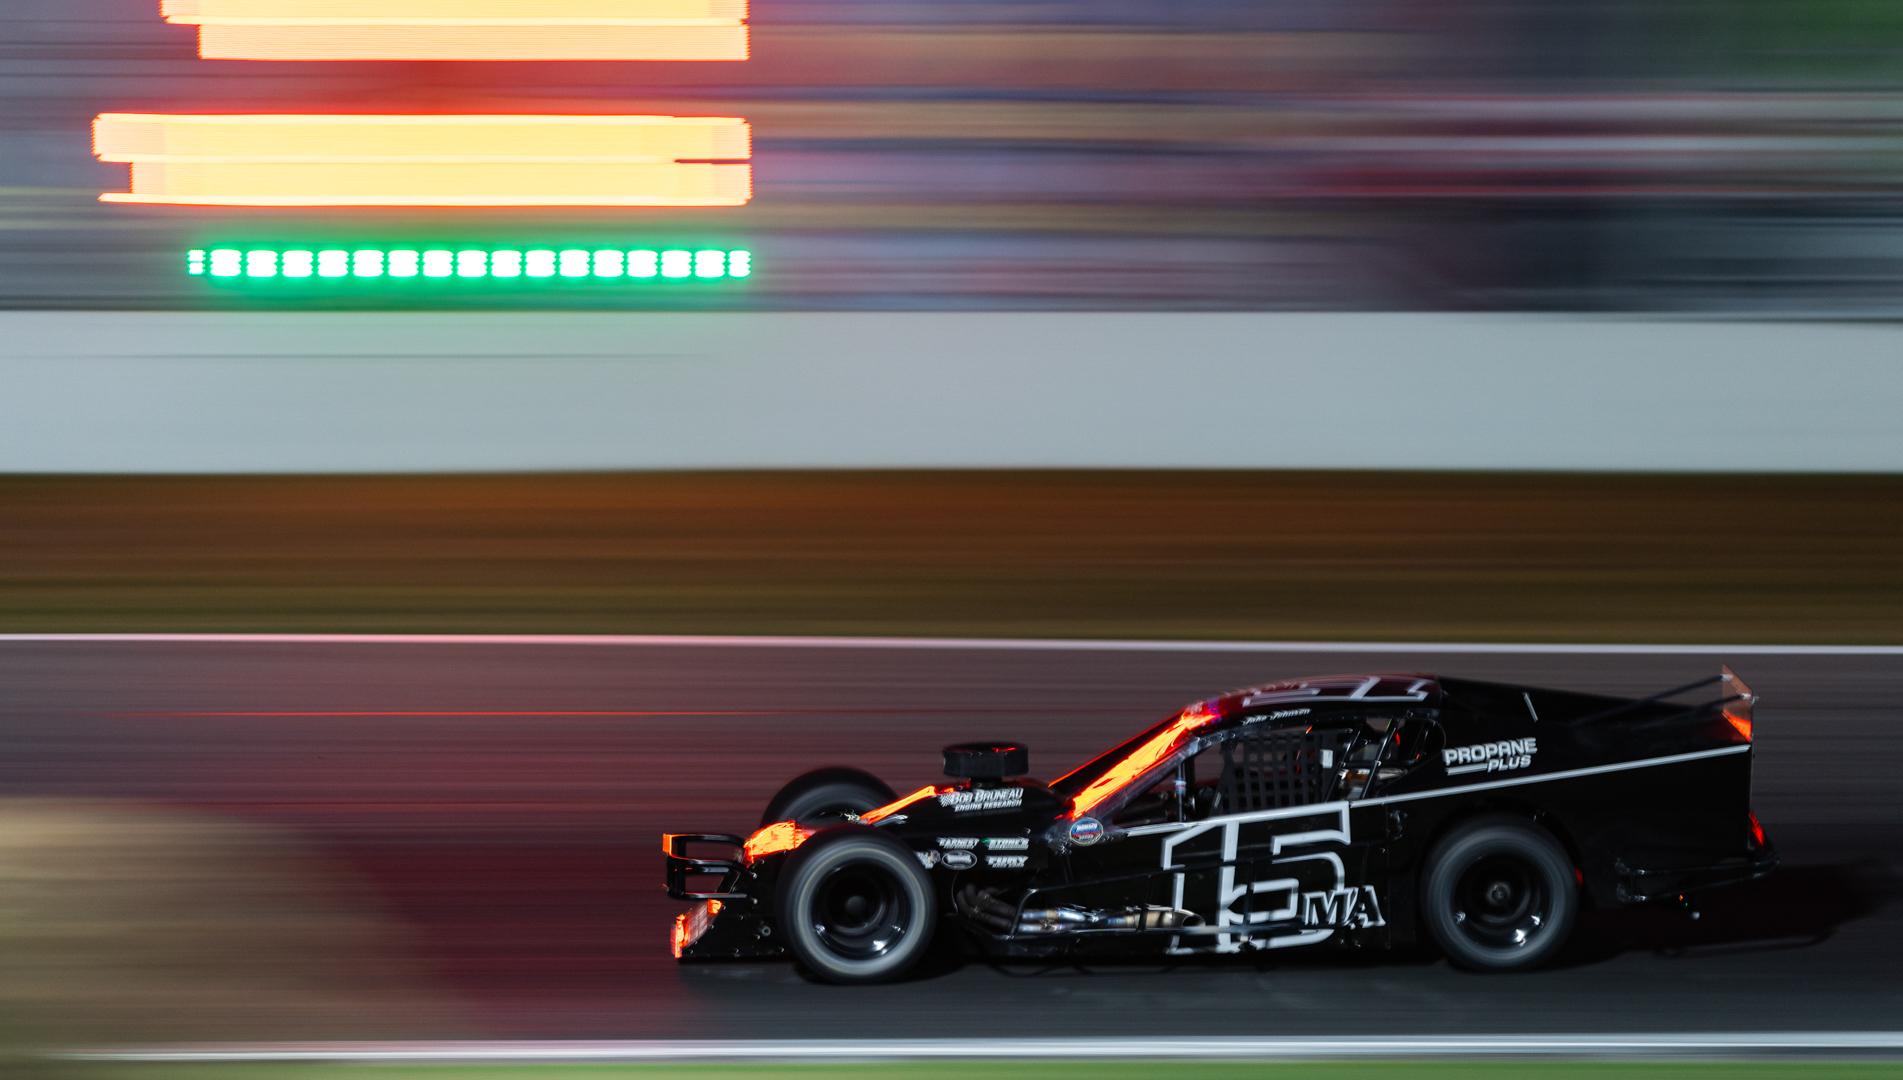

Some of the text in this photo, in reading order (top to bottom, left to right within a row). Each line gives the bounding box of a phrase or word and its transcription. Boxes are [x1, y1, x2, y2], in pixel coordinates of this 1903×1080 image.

[1441, 737, 1538, 766] PROPANE
[1487, 754, 1532, 773] PLUS
[954, 799, 1022, 812] ENGINE RESEARCH
[1161, 800, 1351, 953] 15
[1302, 885, 1386, 928] MA
